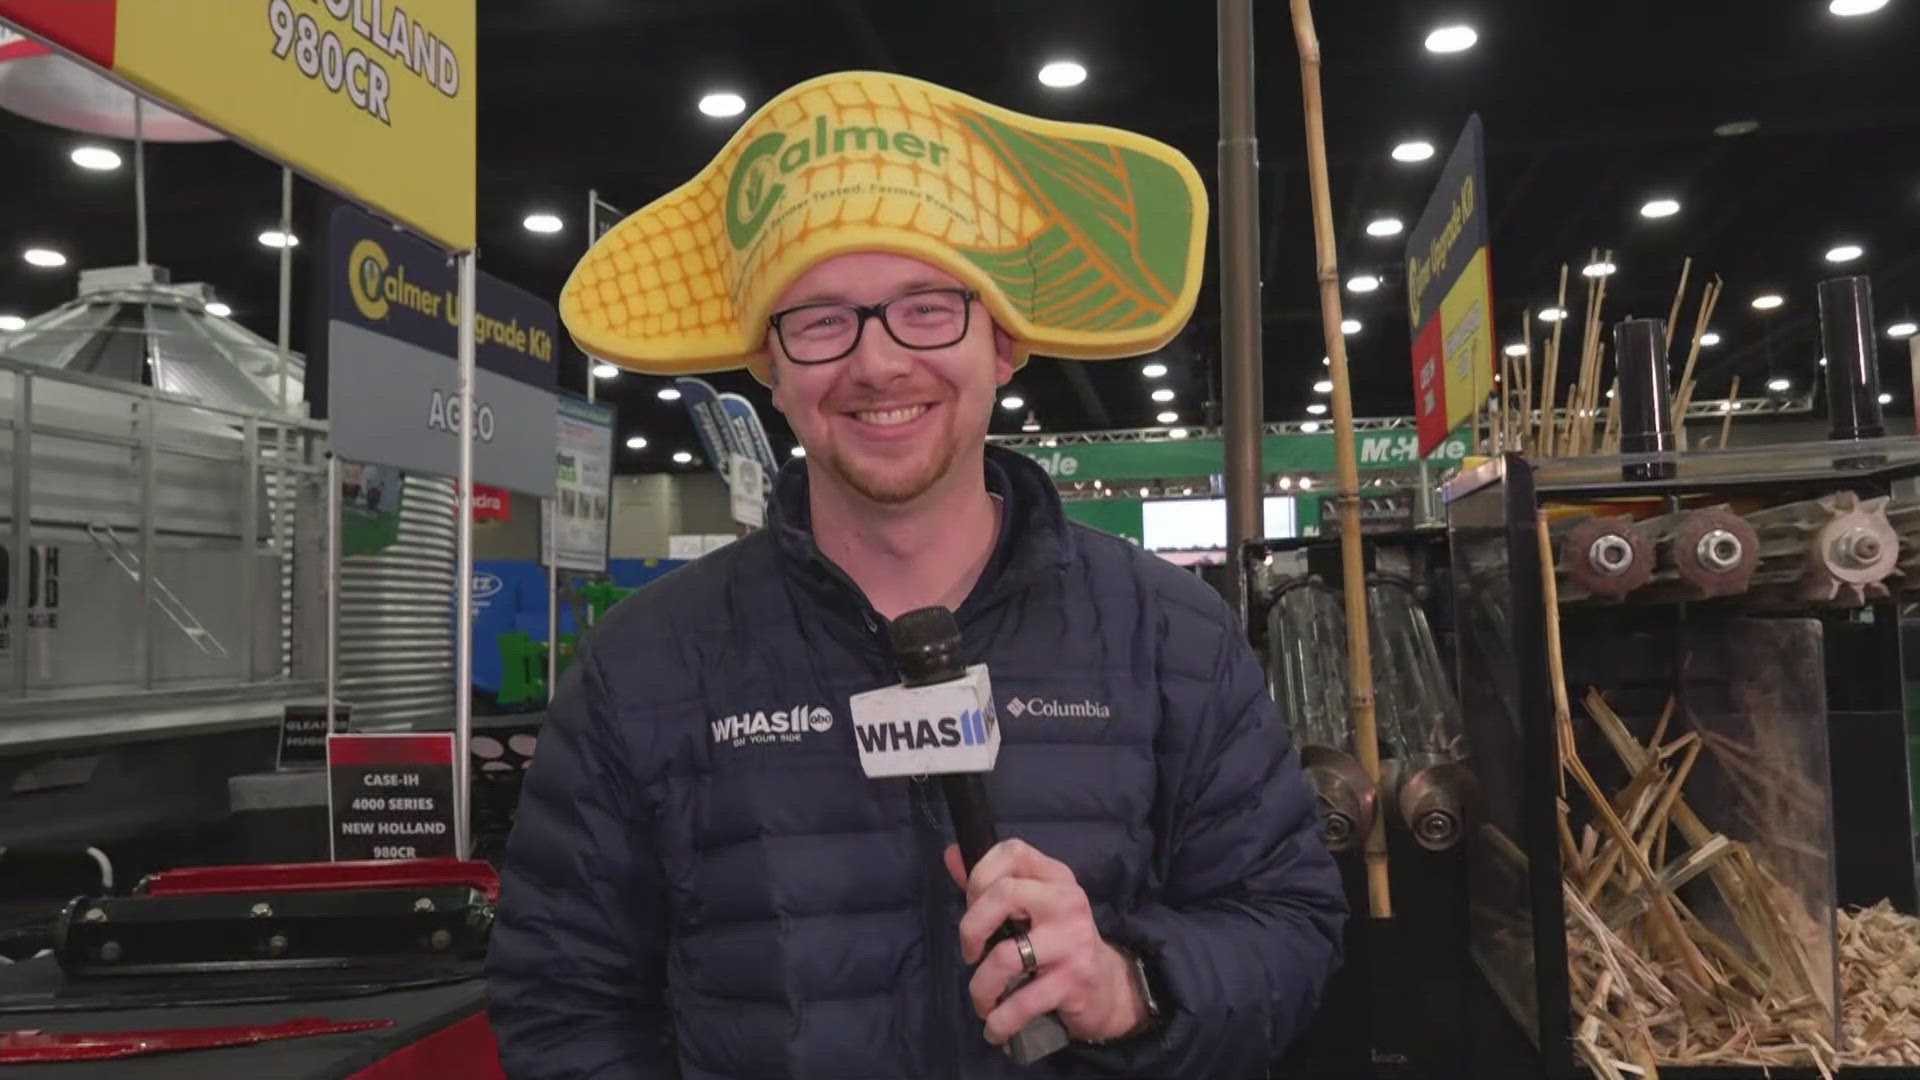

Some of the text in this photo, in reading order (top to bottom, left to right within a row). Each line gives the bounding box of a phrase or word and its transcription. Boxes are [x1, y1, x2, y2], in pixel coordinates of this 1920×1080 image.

[269, 0, 391, 127] 980CR
[726, 115, 949, 251] Calmer
[349, 239, 552, 363] Calmer Ugrade Kit
[428, 390, 495, 442] AGO
[1027, 698, 1110, 719] Columbia
[733, 733, 802, 748] ON YOUR SIDE
[363, 774, 419, 786] CASE-IH
[352, 798, 434, 810] 4000 SERIES
[342, 823, 446, 835] NEW HOLLAND
[373, 846, 416, 859] 980CR
